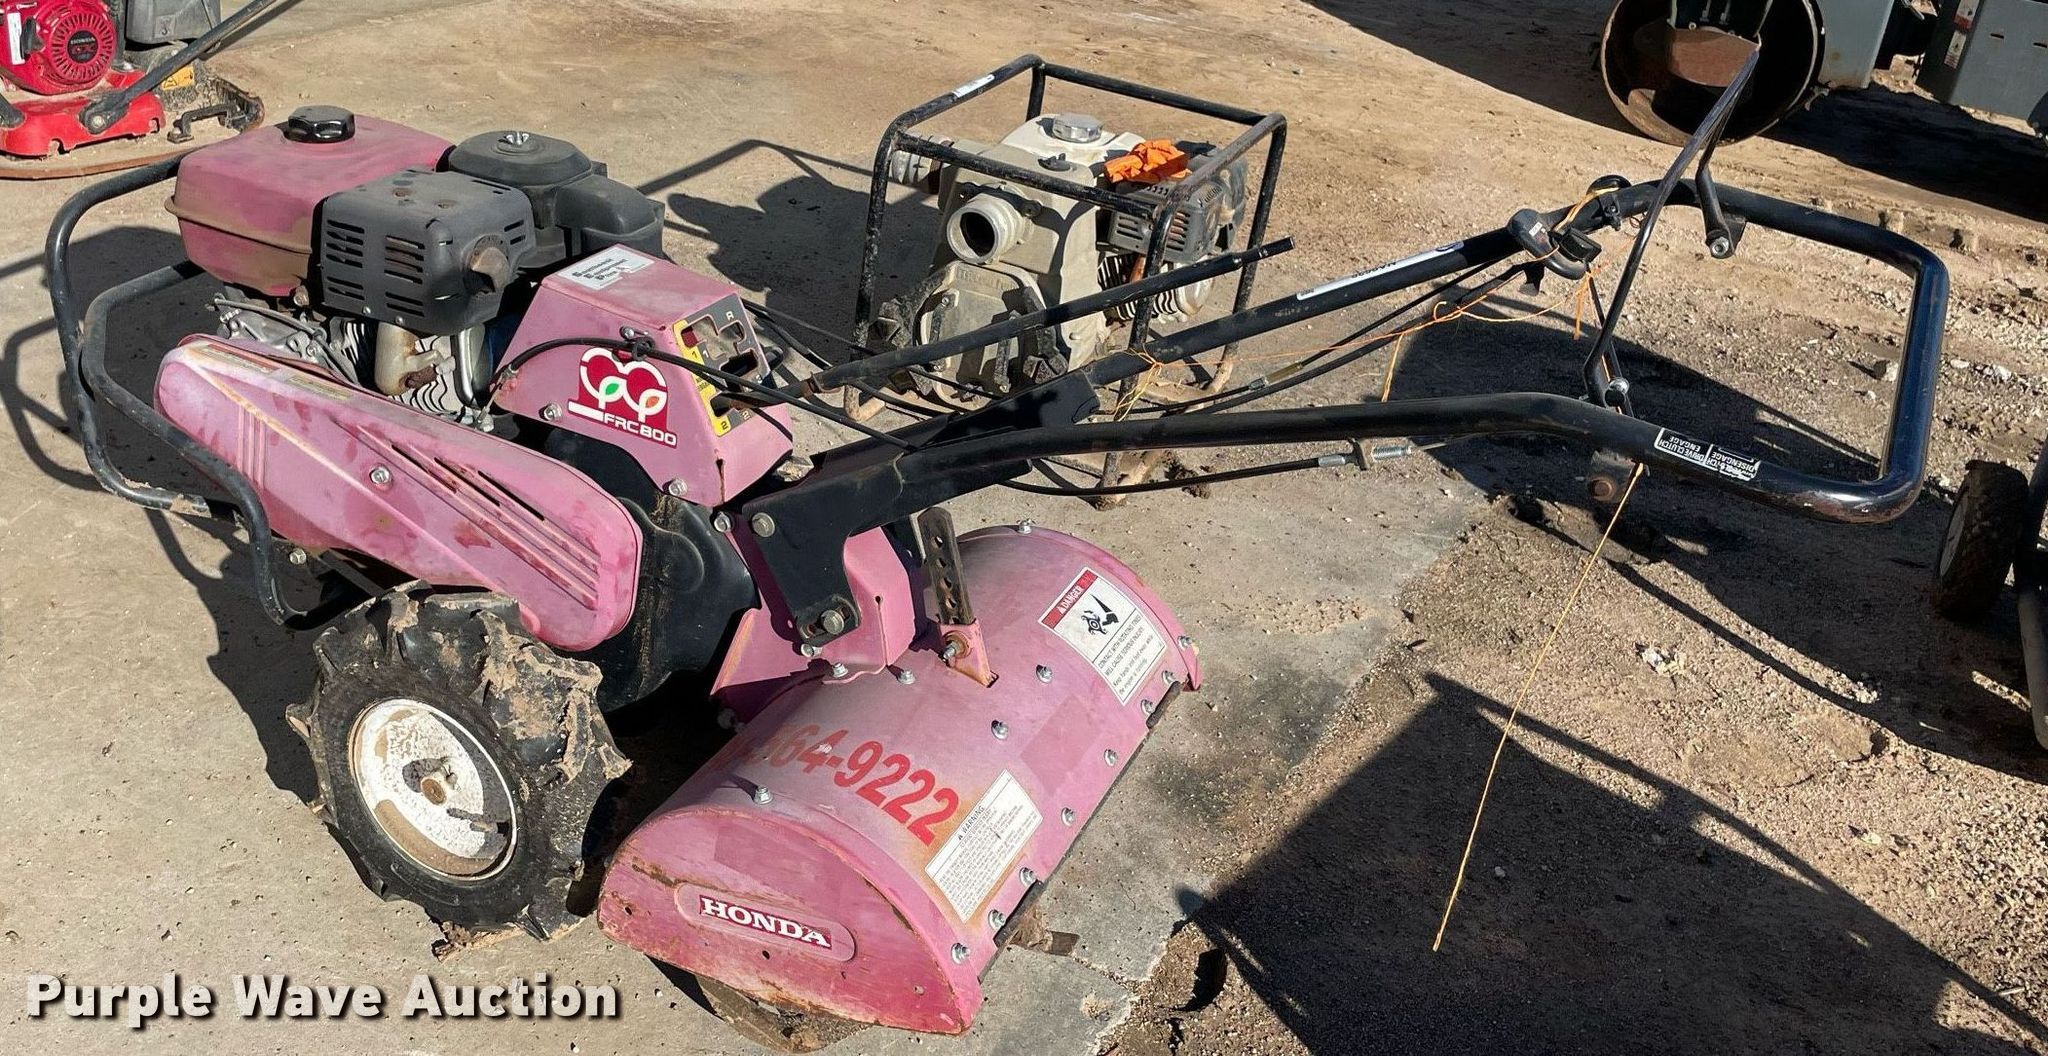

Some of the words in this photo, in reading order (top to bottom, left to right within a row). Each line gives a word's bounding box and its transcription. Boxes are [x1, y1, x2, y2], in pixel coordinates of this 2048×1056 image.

[70, 36, 95, 46] HONDA
[726, 310, 735, 320] R
[742, 410, 751, 420] 2
[604, 412, 678, 447] FRC800
[720, 420, 729, 431] 2
[1659, 439, 1685, 453] CLUTCH
[1669, 436, 1701, 451] ENGAGE
[1684, 449, 1705, 462] DRIVE
[1711, 451, 1755, 472] DISENGAGE
[1063, 584, 1083, 609] DANGER
[748, 725, 959, 847] 64-9222
[961, 805, 985, 833] WARNING
[701, 897, 831, 948] HONDA
